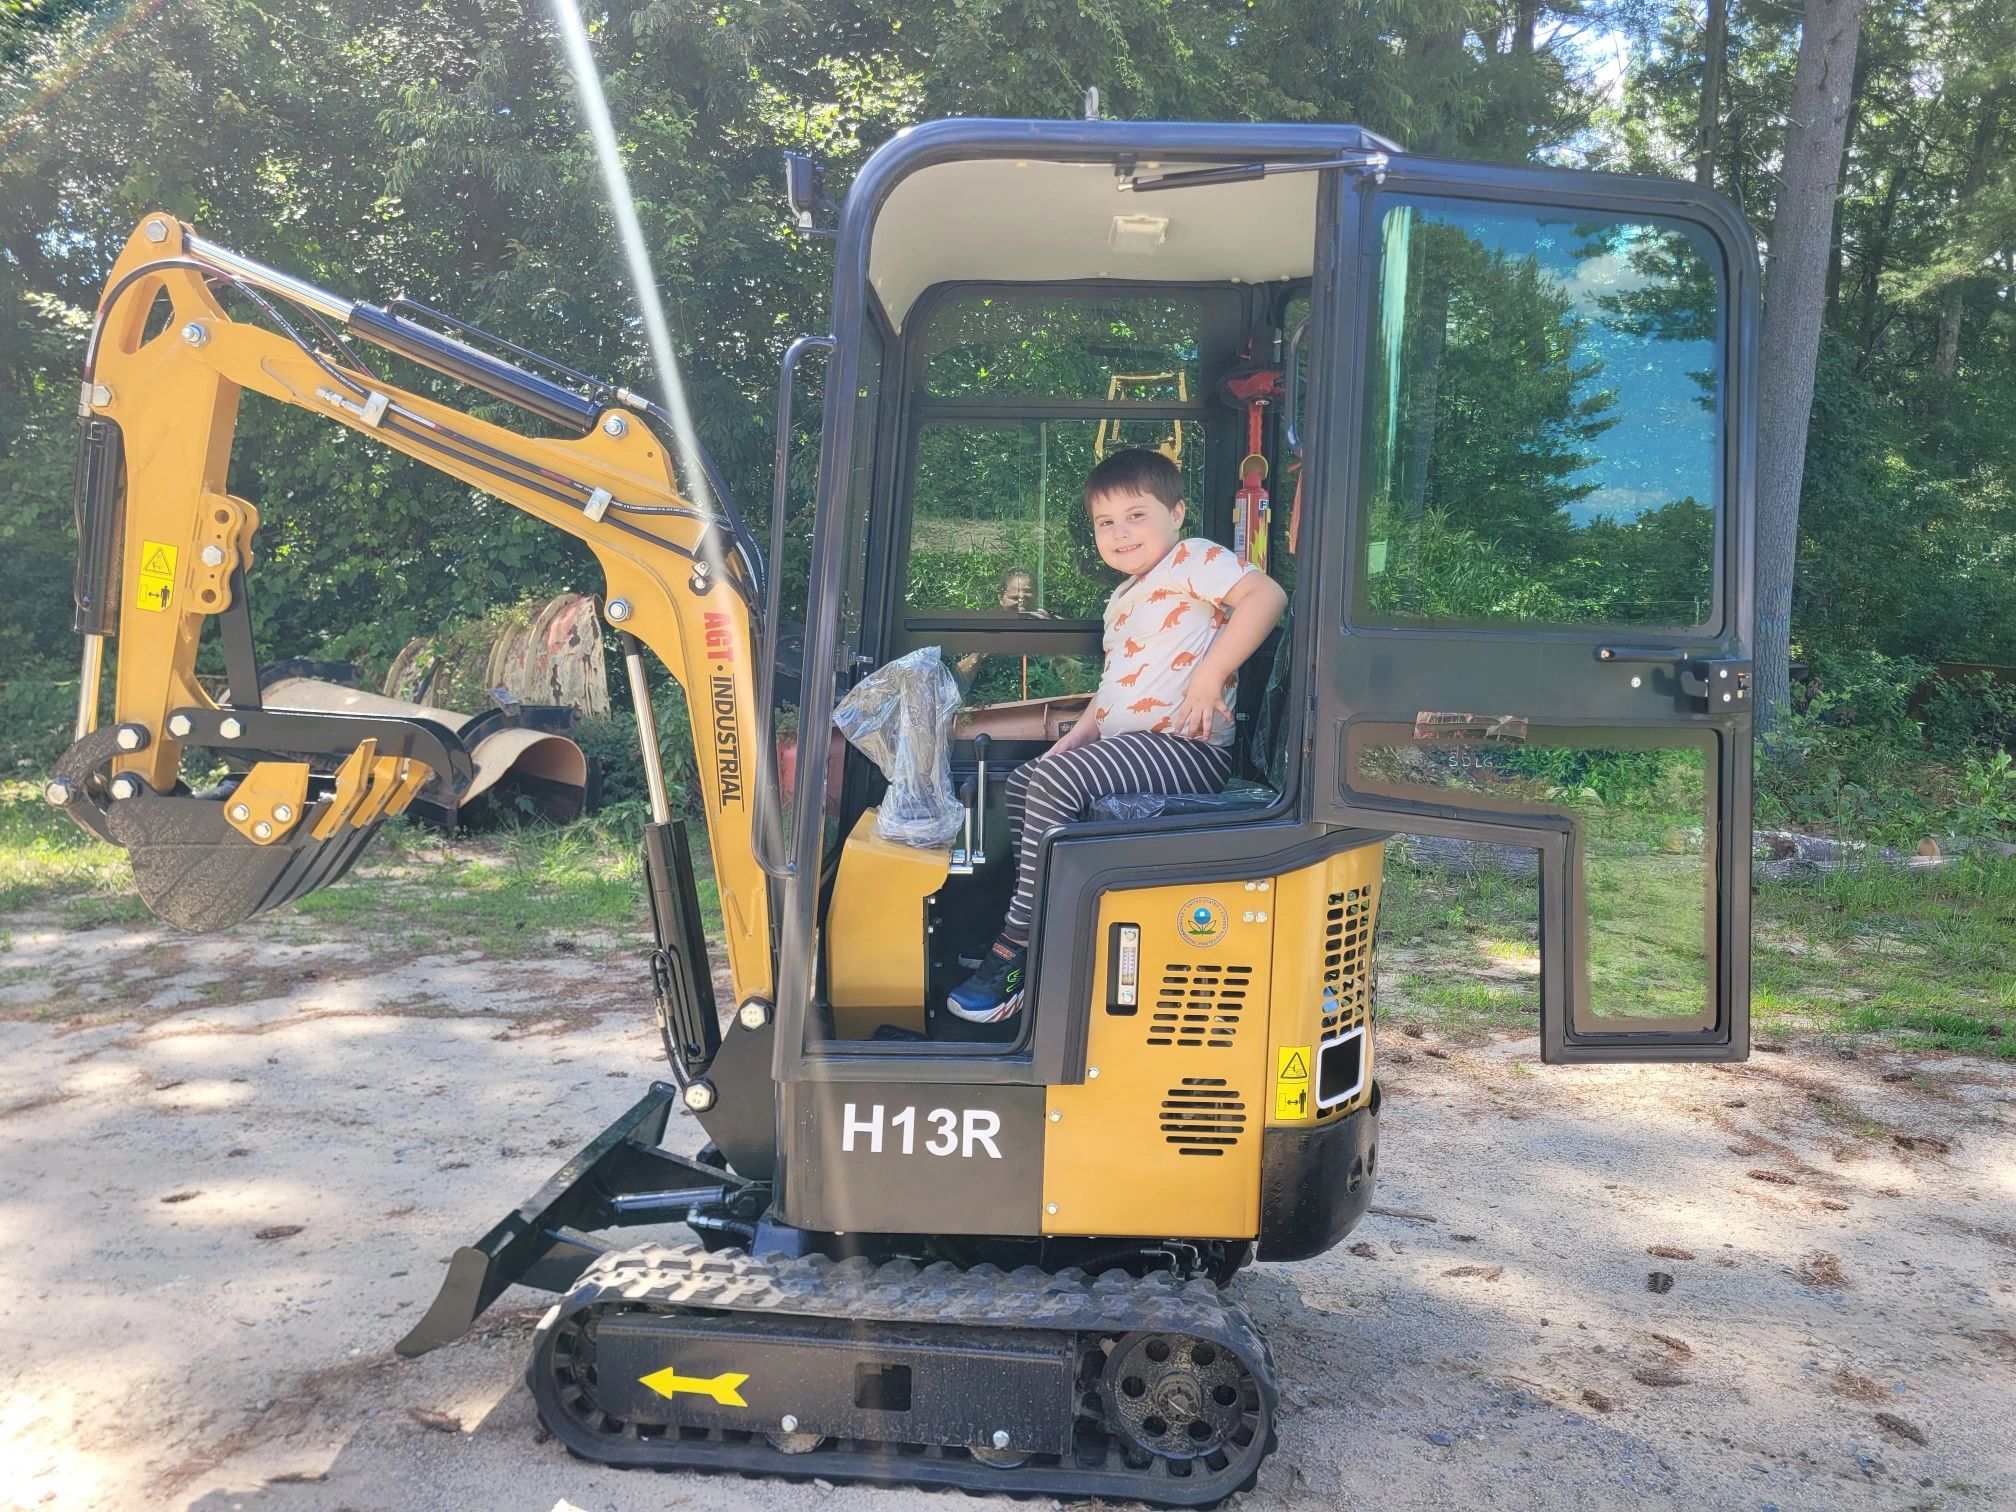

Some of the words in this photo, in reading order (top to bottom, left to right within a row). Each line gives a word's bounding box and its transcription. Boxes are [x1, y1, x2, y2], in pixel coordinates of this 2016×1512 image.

[704, 612, 733, 663] AGT
[713, 676, 741, 807] INDUSTRIAL
[1448, 756, 1493, 768] SDLG
[842, 1103, 1003, 1159] H13R
